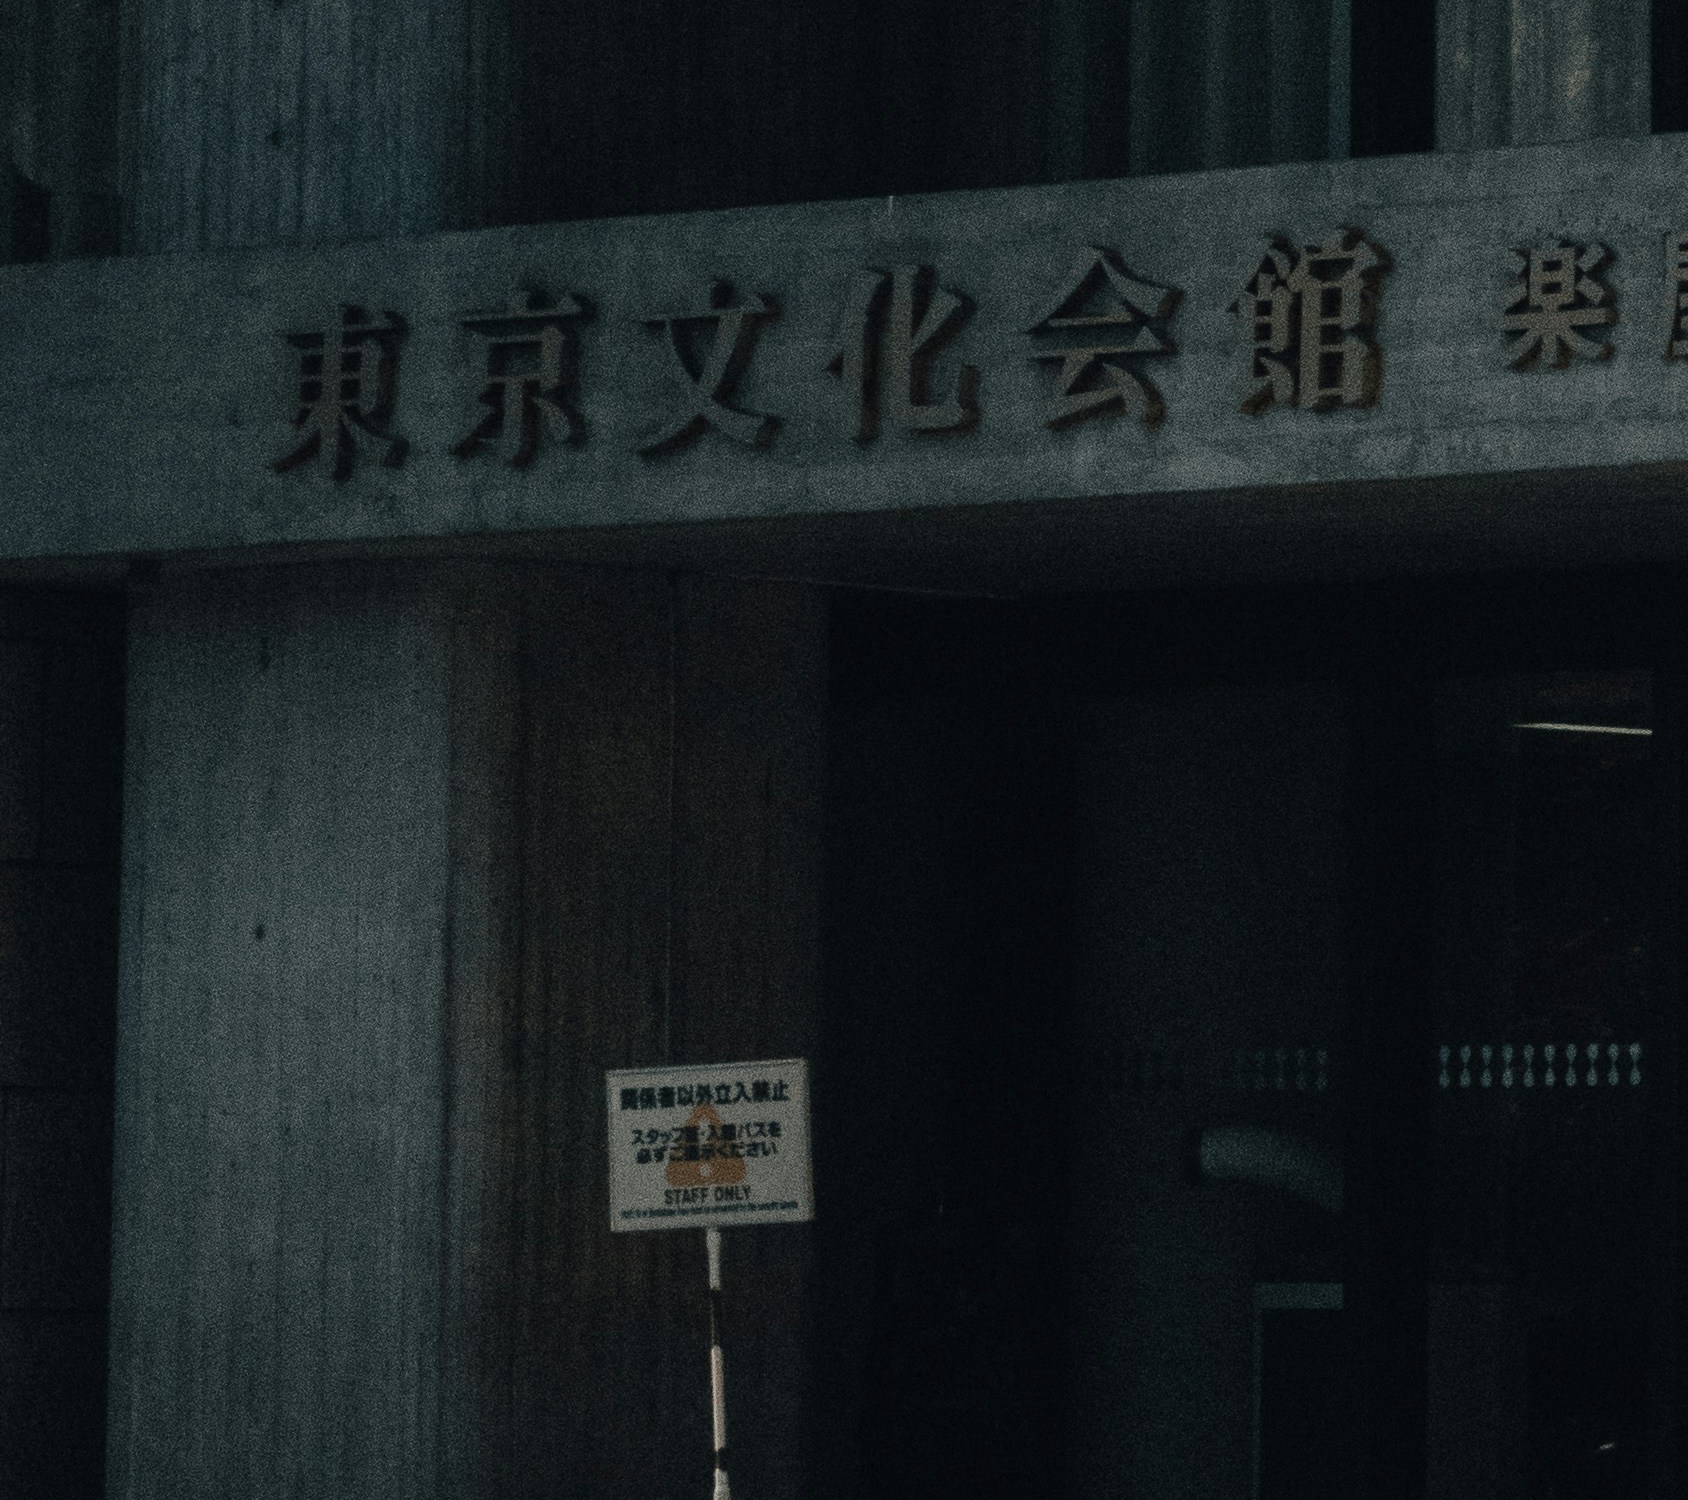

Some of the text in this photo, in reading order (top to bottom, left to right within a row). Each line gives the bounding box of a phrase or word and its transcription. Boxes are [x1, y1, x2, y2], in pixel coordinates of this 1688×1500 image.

[271, 227, 1394, 482] 東京文化会館
[620, 1080, 790, 1111] 関係者以外立入禁止
[664, 1184, 752, 1206] STAFF ONLY
